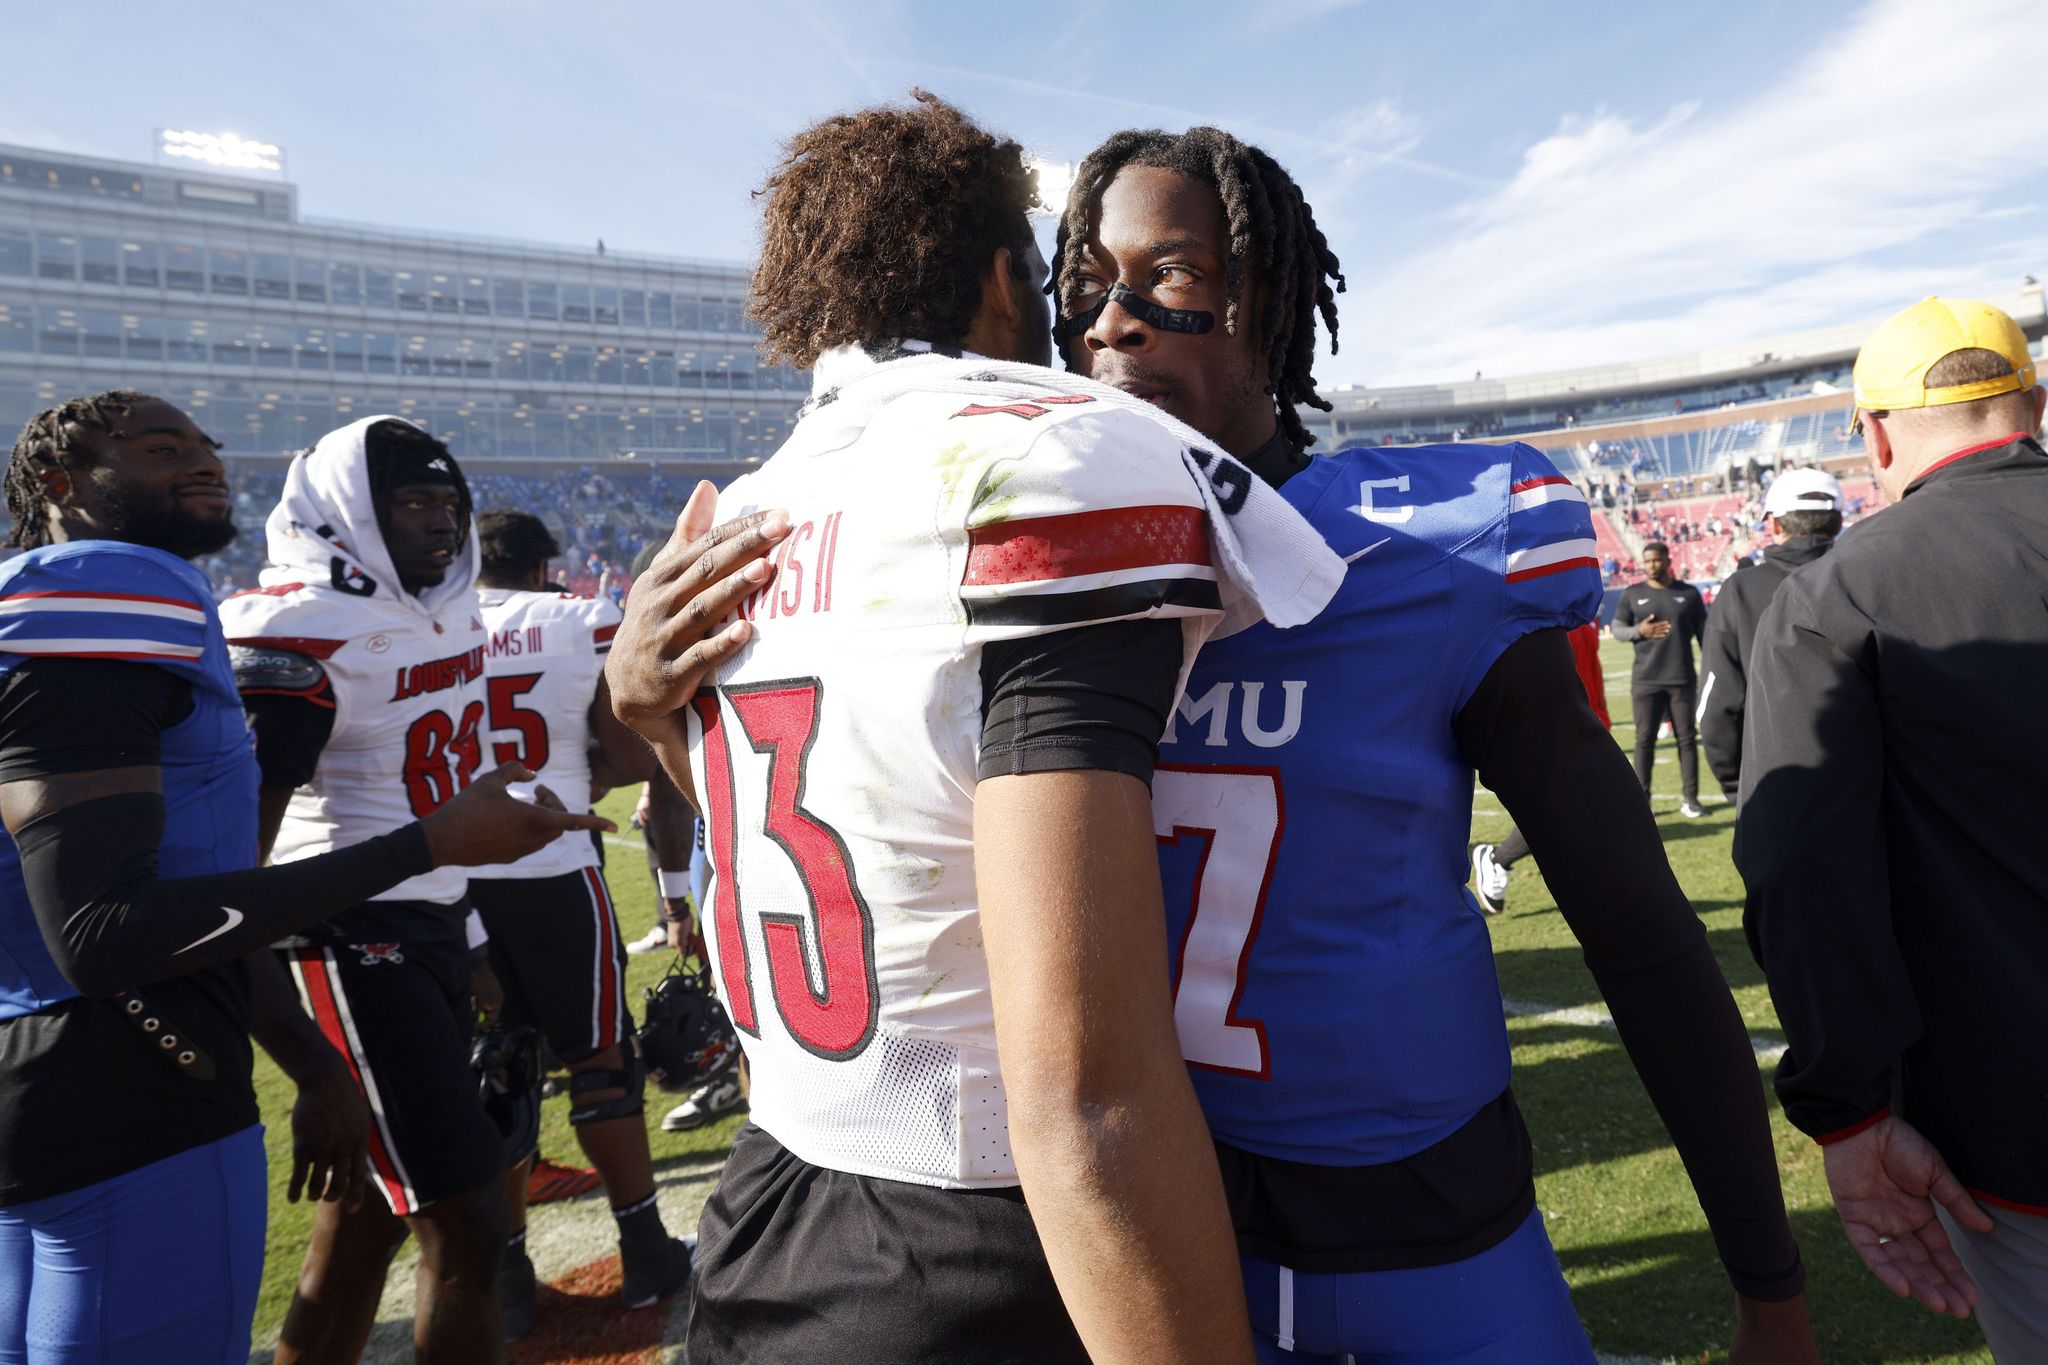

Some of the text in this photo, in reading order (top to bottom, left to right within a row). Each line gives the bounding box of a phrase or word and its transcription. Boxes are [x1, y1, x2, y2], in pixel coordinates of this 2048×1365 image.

[1360, 475, 1414, 523] C
[690, 676, 878, 1063] 13
[1152, 762, 1287, 1081] 7
